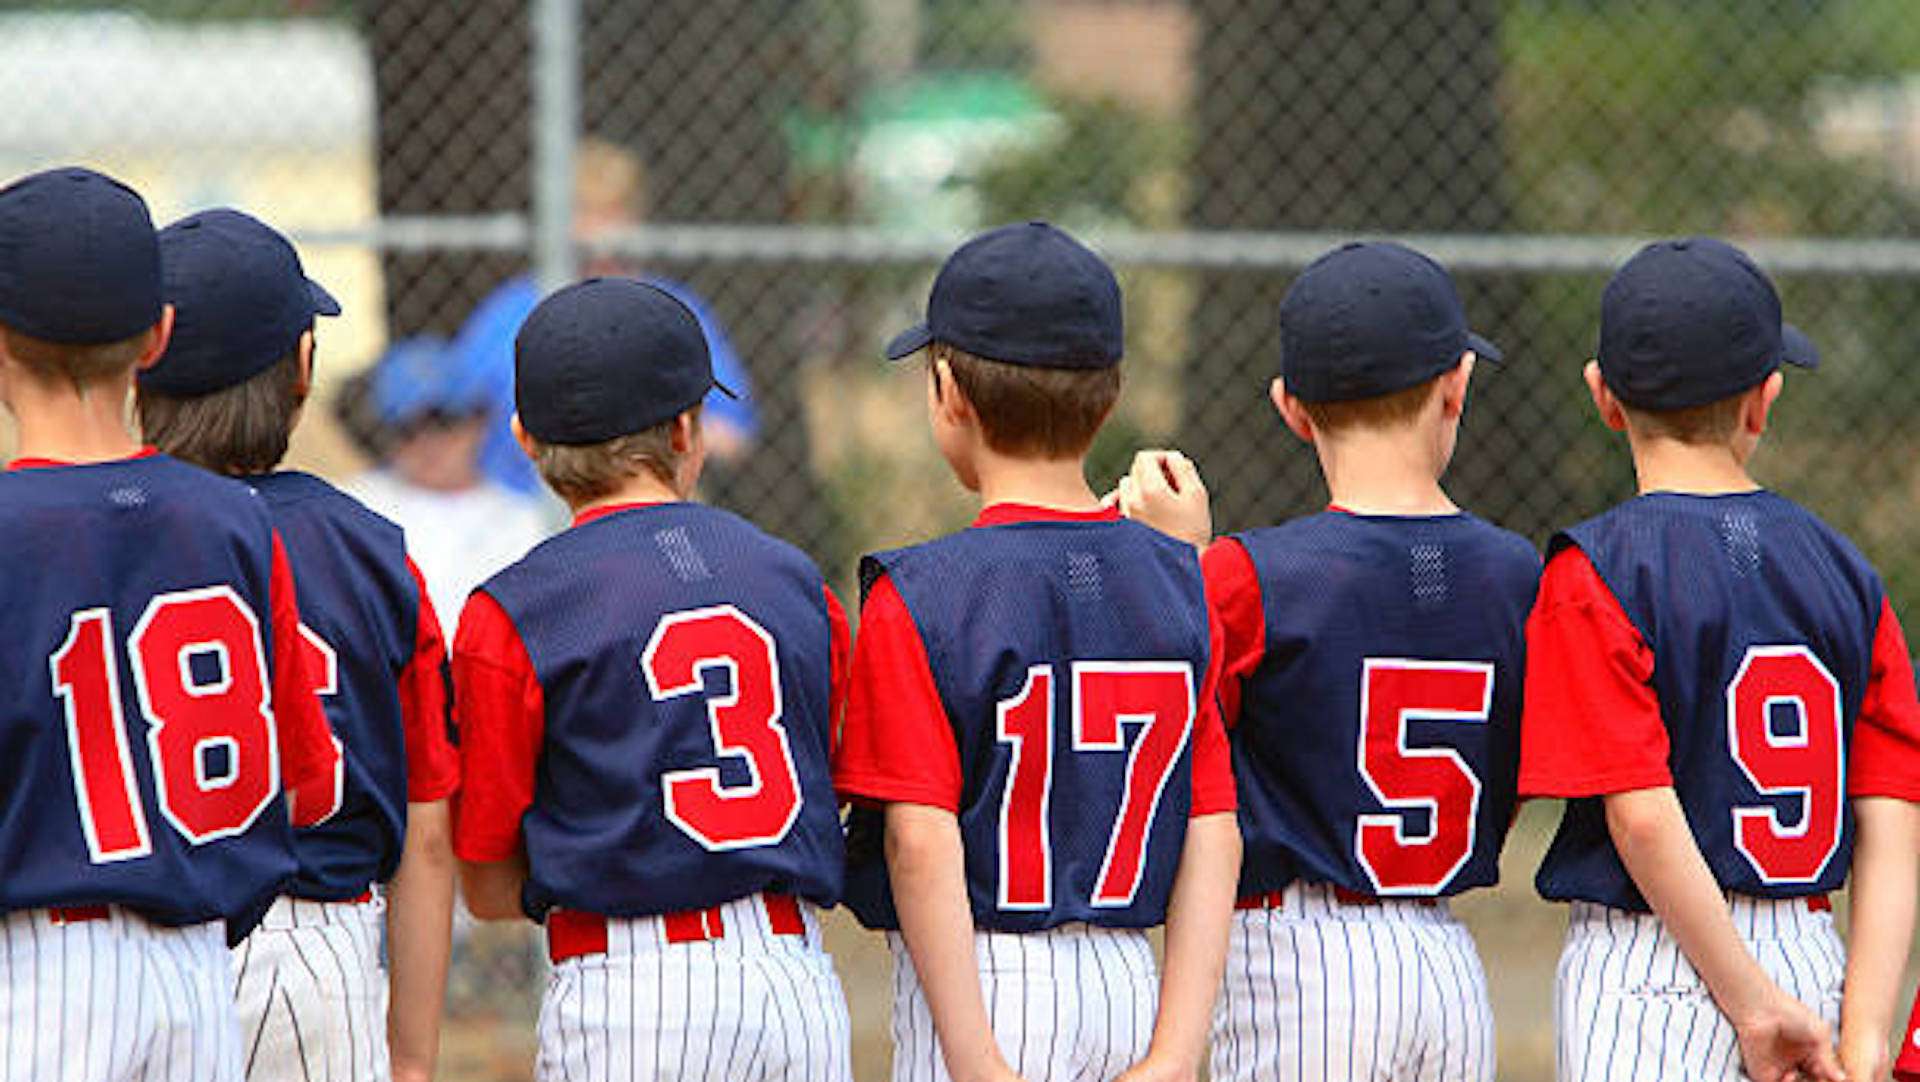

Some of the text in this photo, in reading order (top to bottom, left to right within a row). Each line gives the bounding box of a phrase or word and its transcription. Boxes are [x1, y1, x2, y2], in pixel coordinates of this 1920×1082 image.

[50, 585, 281, 863] 18
[641, 604, 803, 850] 3
[995, 661, 1195, 911] 17
[1356, 657, 1494, 896] 5
[1727, 645, 1845, 885] 9
